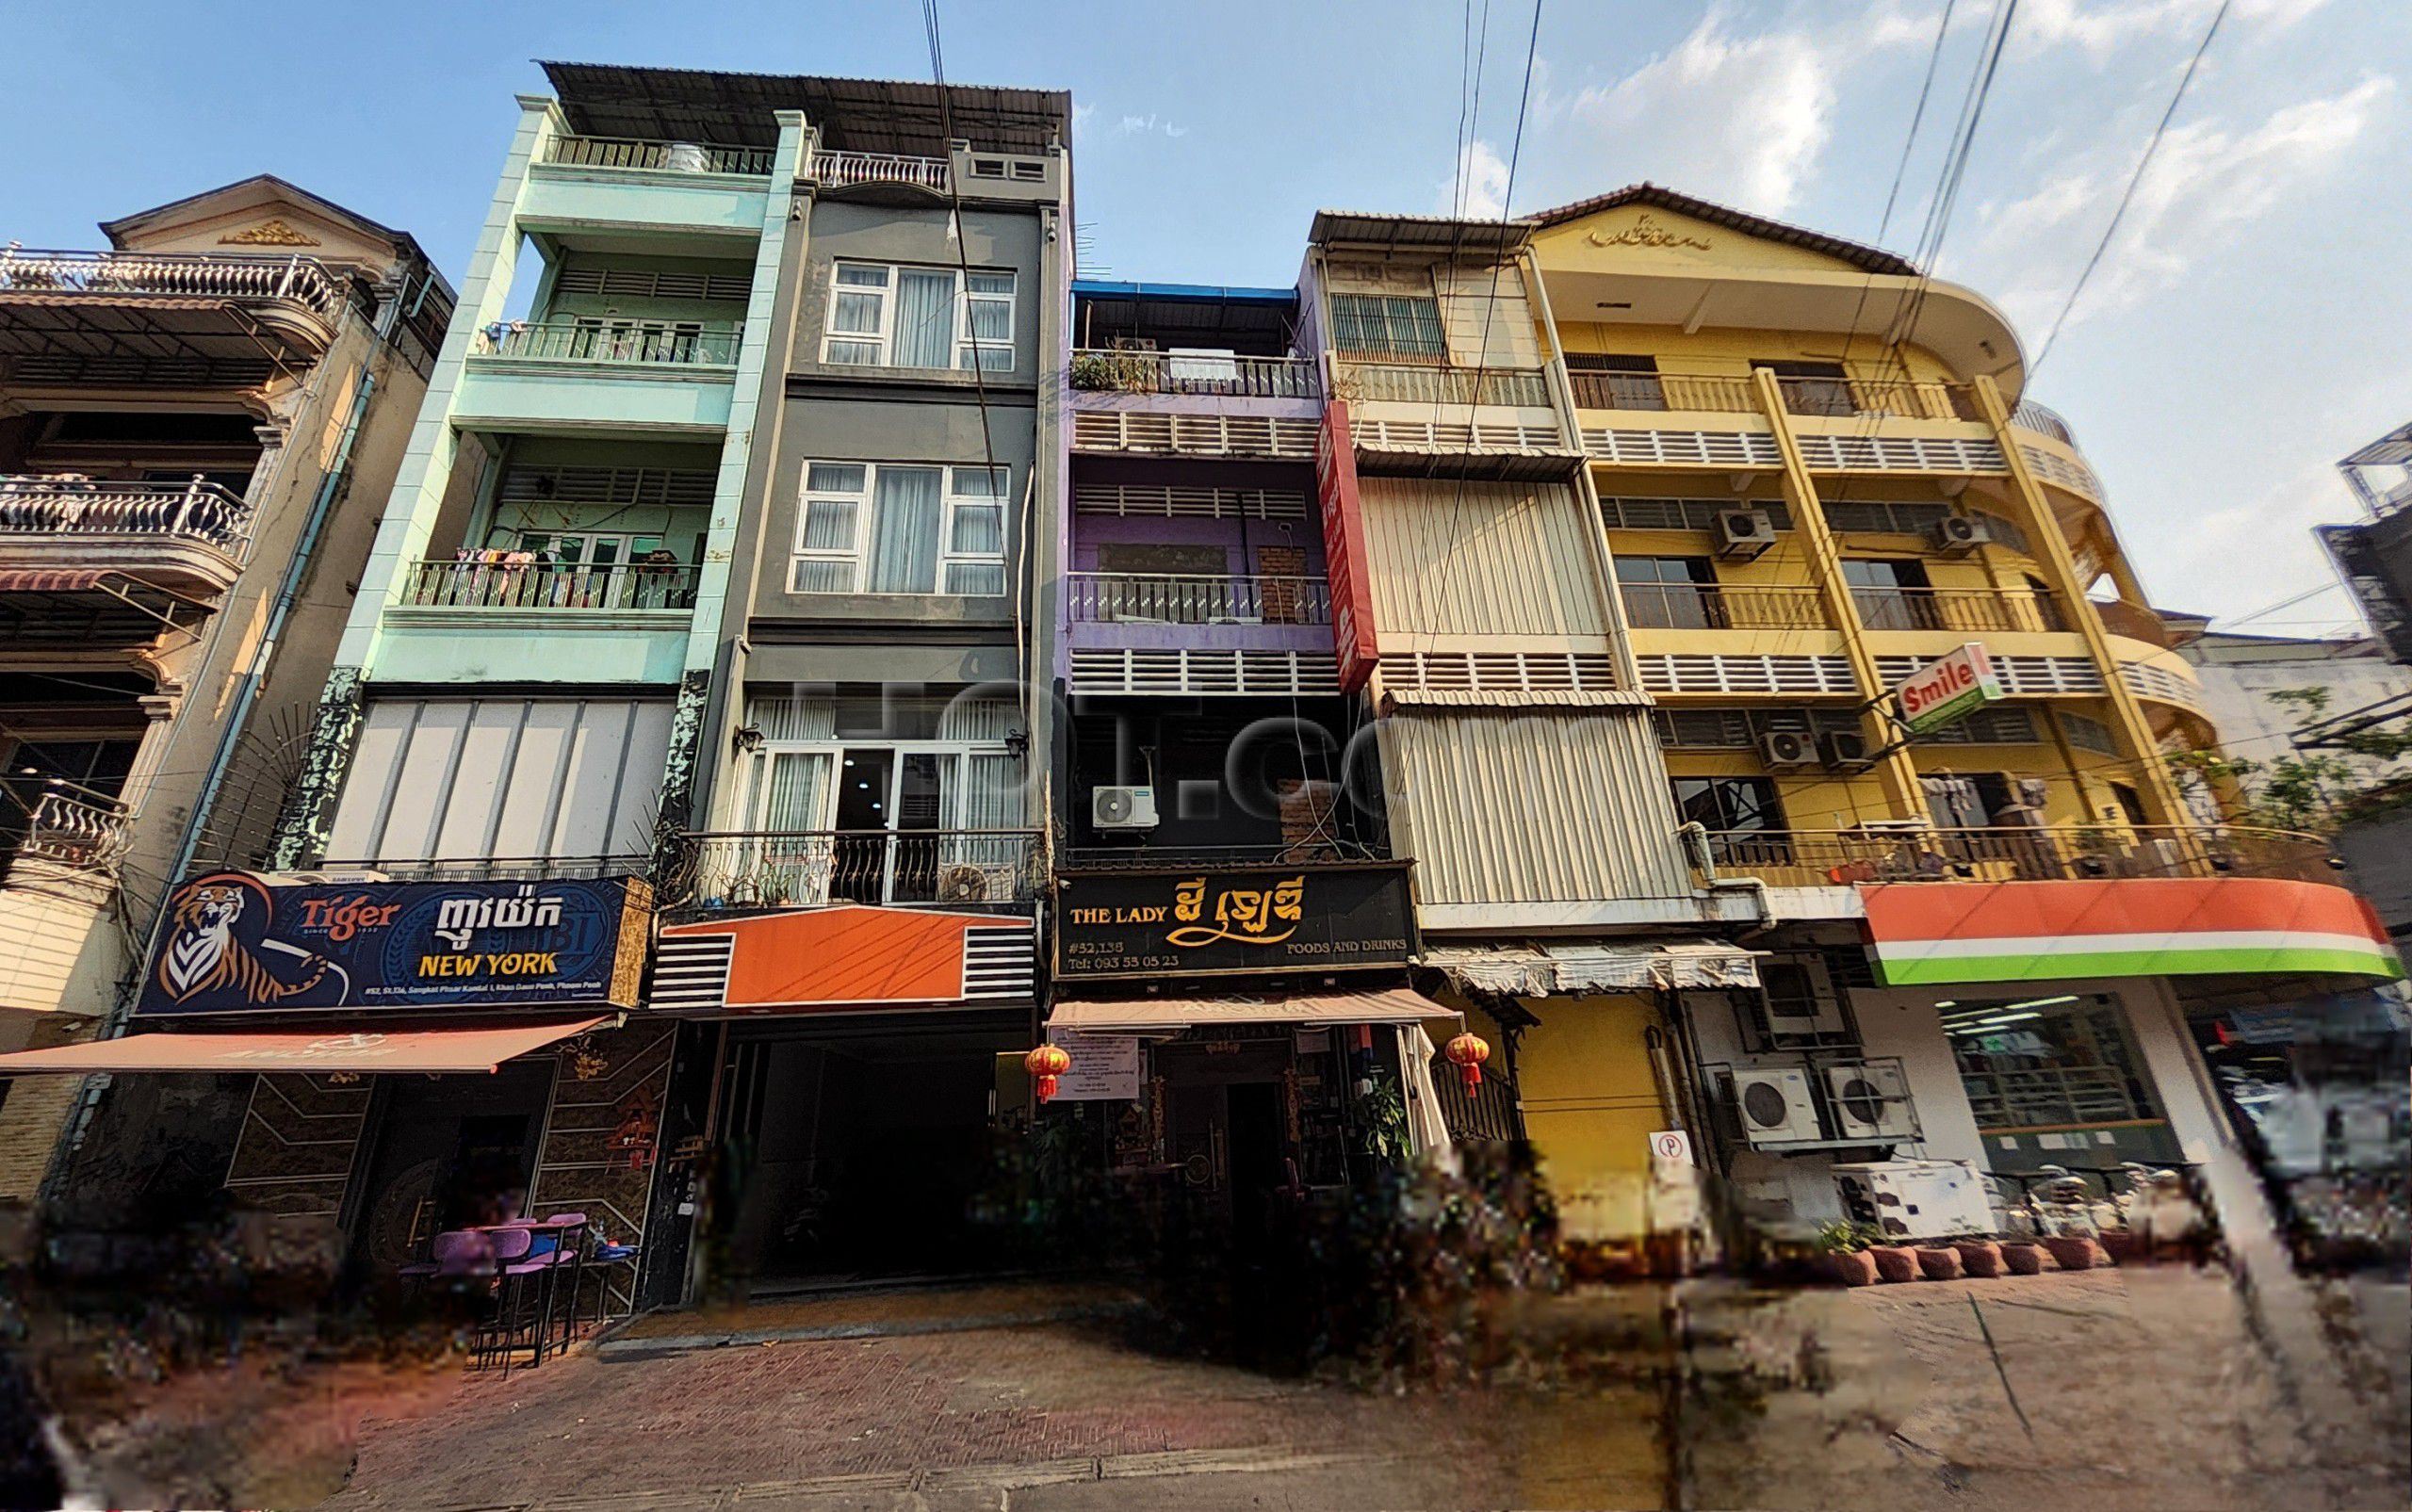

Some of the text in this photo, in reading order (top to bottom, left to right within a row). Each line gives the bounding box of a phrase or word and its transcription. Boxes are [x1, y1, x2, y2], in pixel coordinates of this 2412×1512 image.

[1903, 661, 1974, 712] Smile
[301, 895, 402, 941] Tiger
[1069, 905, 1168, 924] THE LADY
[1286, 938, 1408, 954] FOODS AND DRINKS
[418, 951, 560, 977] NEW YORK
[1068, 958, 1091, 969] Tel:
